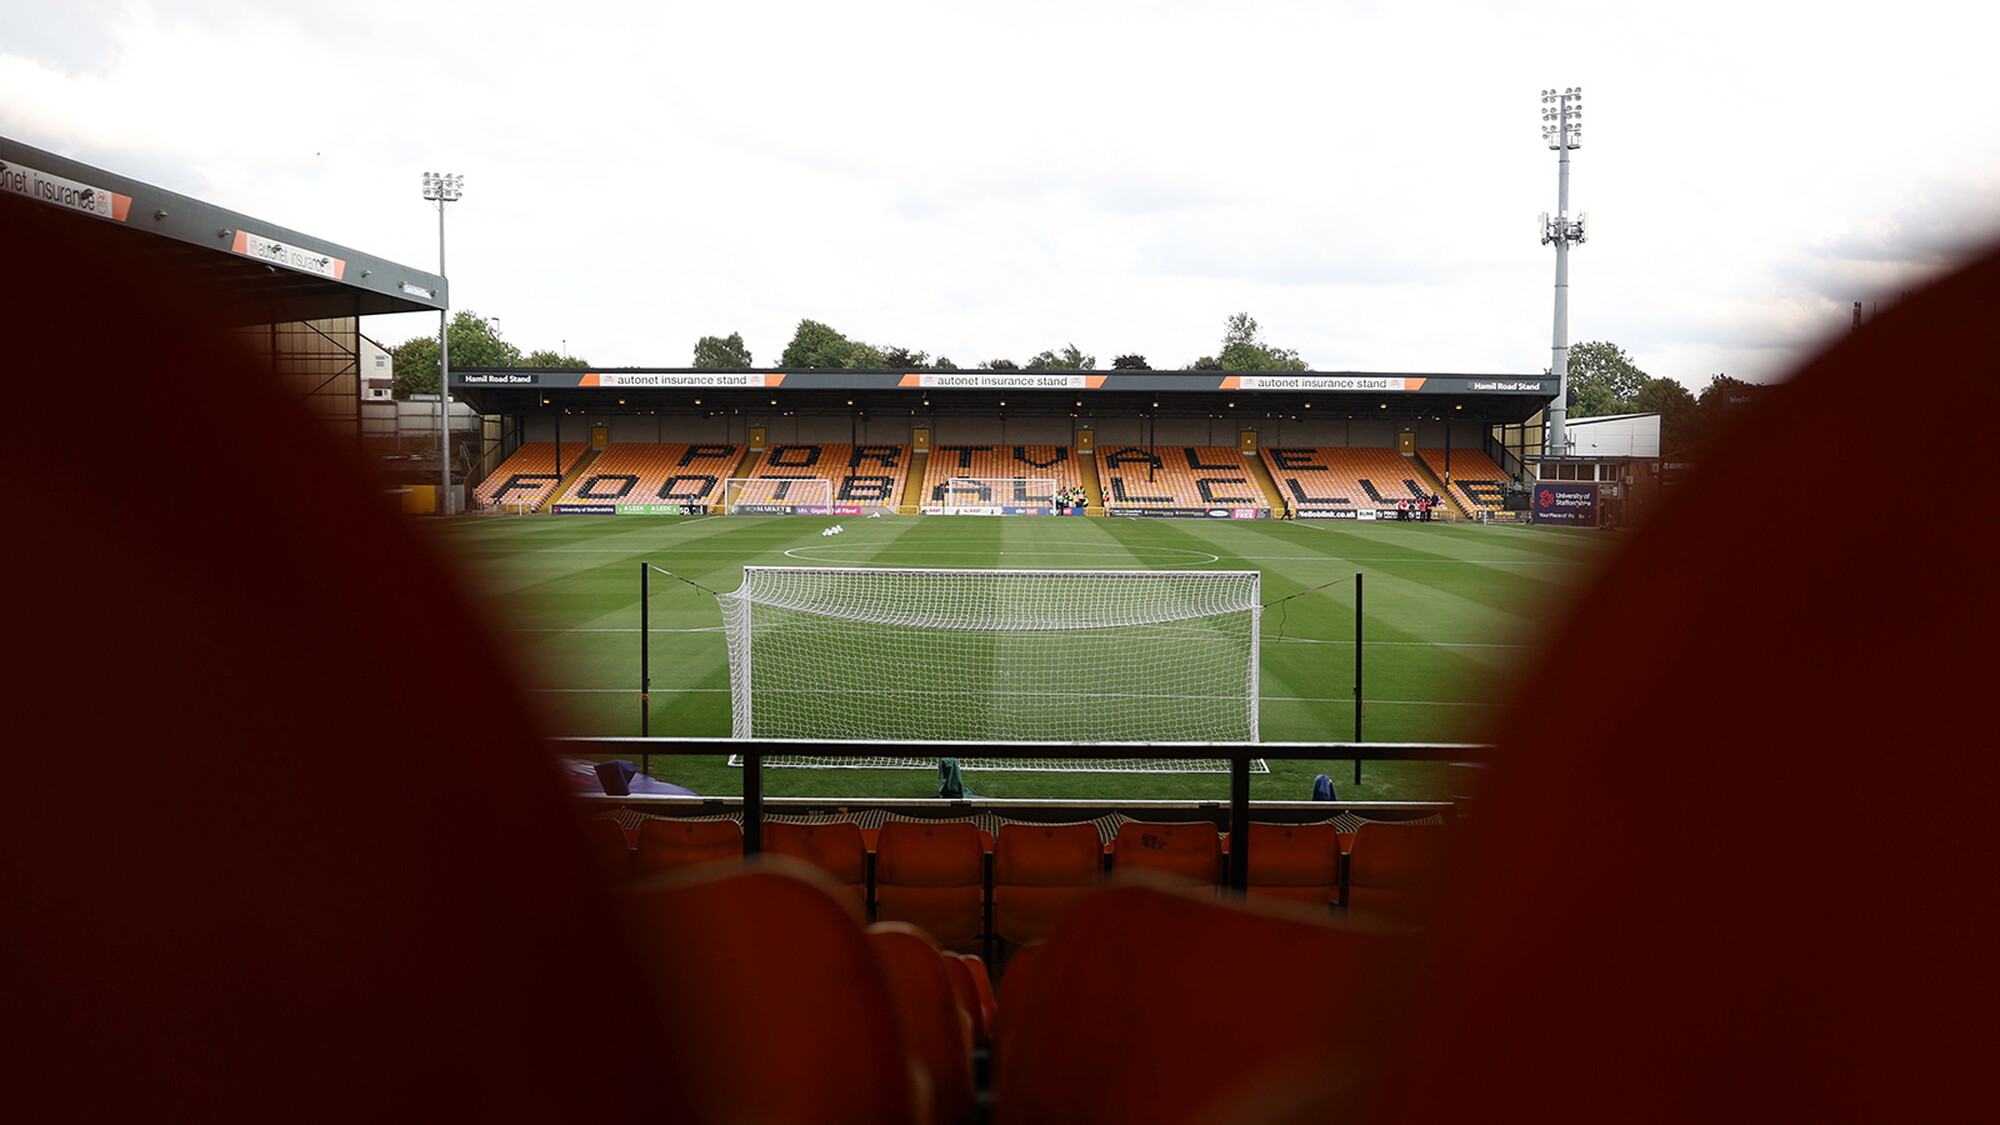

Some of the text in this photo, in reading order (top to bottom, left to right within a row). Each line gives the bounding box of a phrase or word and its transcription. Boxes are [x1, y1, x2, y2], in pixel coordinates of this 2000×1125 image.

[465, 375, 532, 383] Hamil Road Stand
[617, 375, 747, 385] autonet insurance stand
[937, 376, 1068, 386] autonet insurance stand
[1257, 378, 1388, 388] autonet insurance stand
[1474, 382, 1541, 391] Hamil Road Stand
[679, 444, 1329, 471] PORT VALE
[1555, 492, 1583, 501] University
[1583, 492, 1591, 500] of
